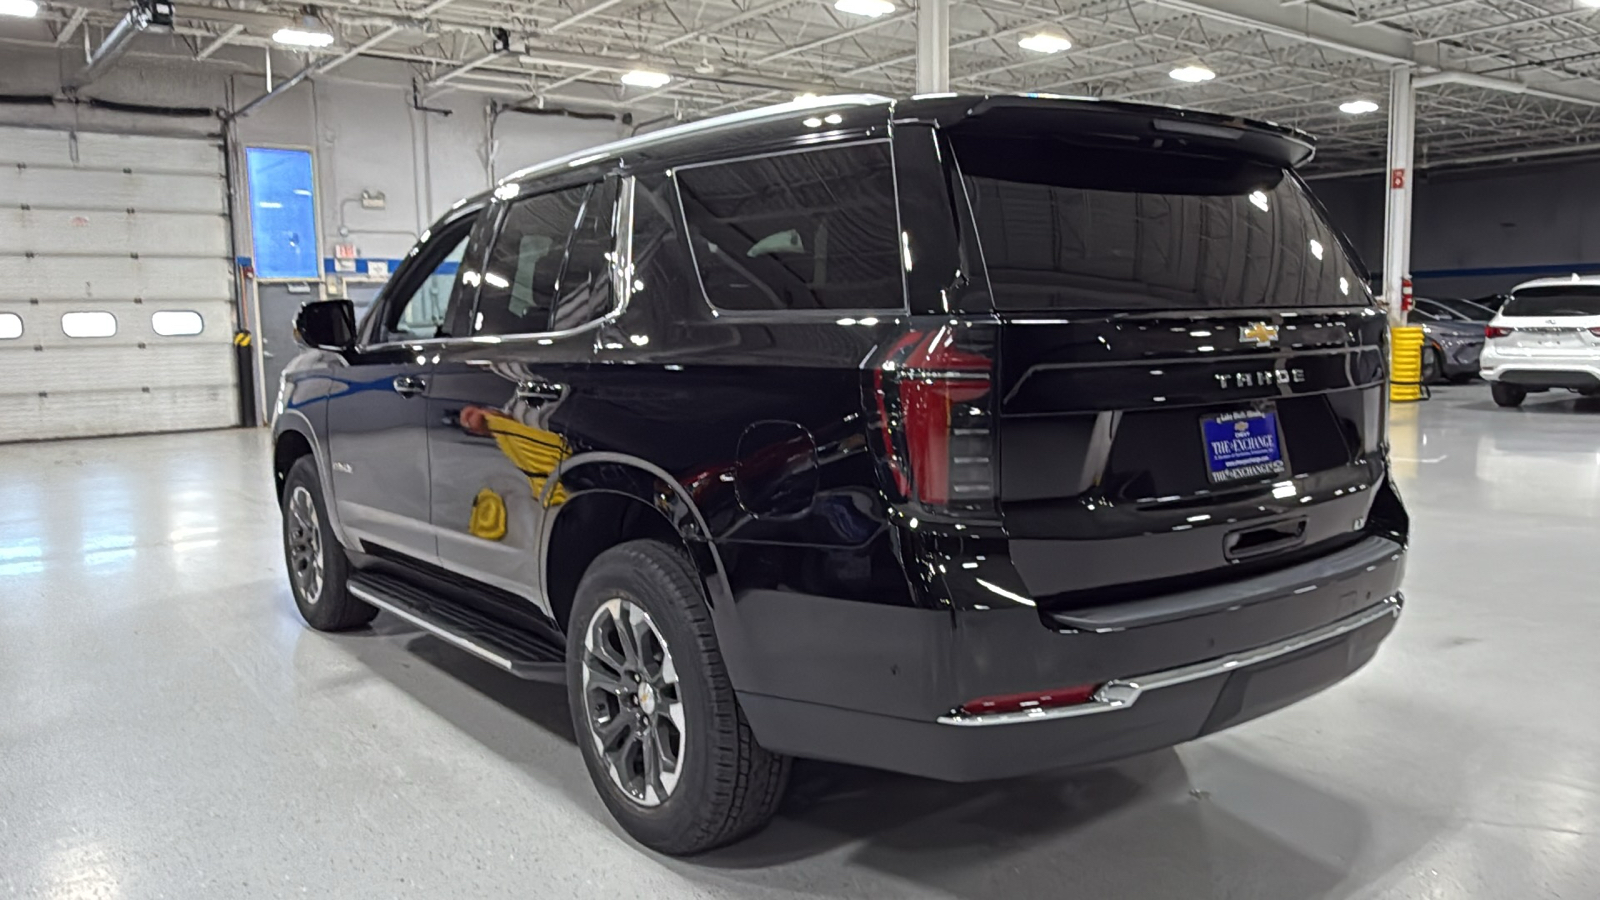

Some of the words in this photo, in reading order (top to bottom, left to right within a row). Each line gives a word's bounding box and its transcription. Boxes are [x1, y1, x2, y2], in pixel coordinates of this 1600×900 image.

[1214, 368, 1305, 389] TAHOE
[1211, 441, 1231, 455] THE
[1233, 434, 1273, 452] EXCHANGE
